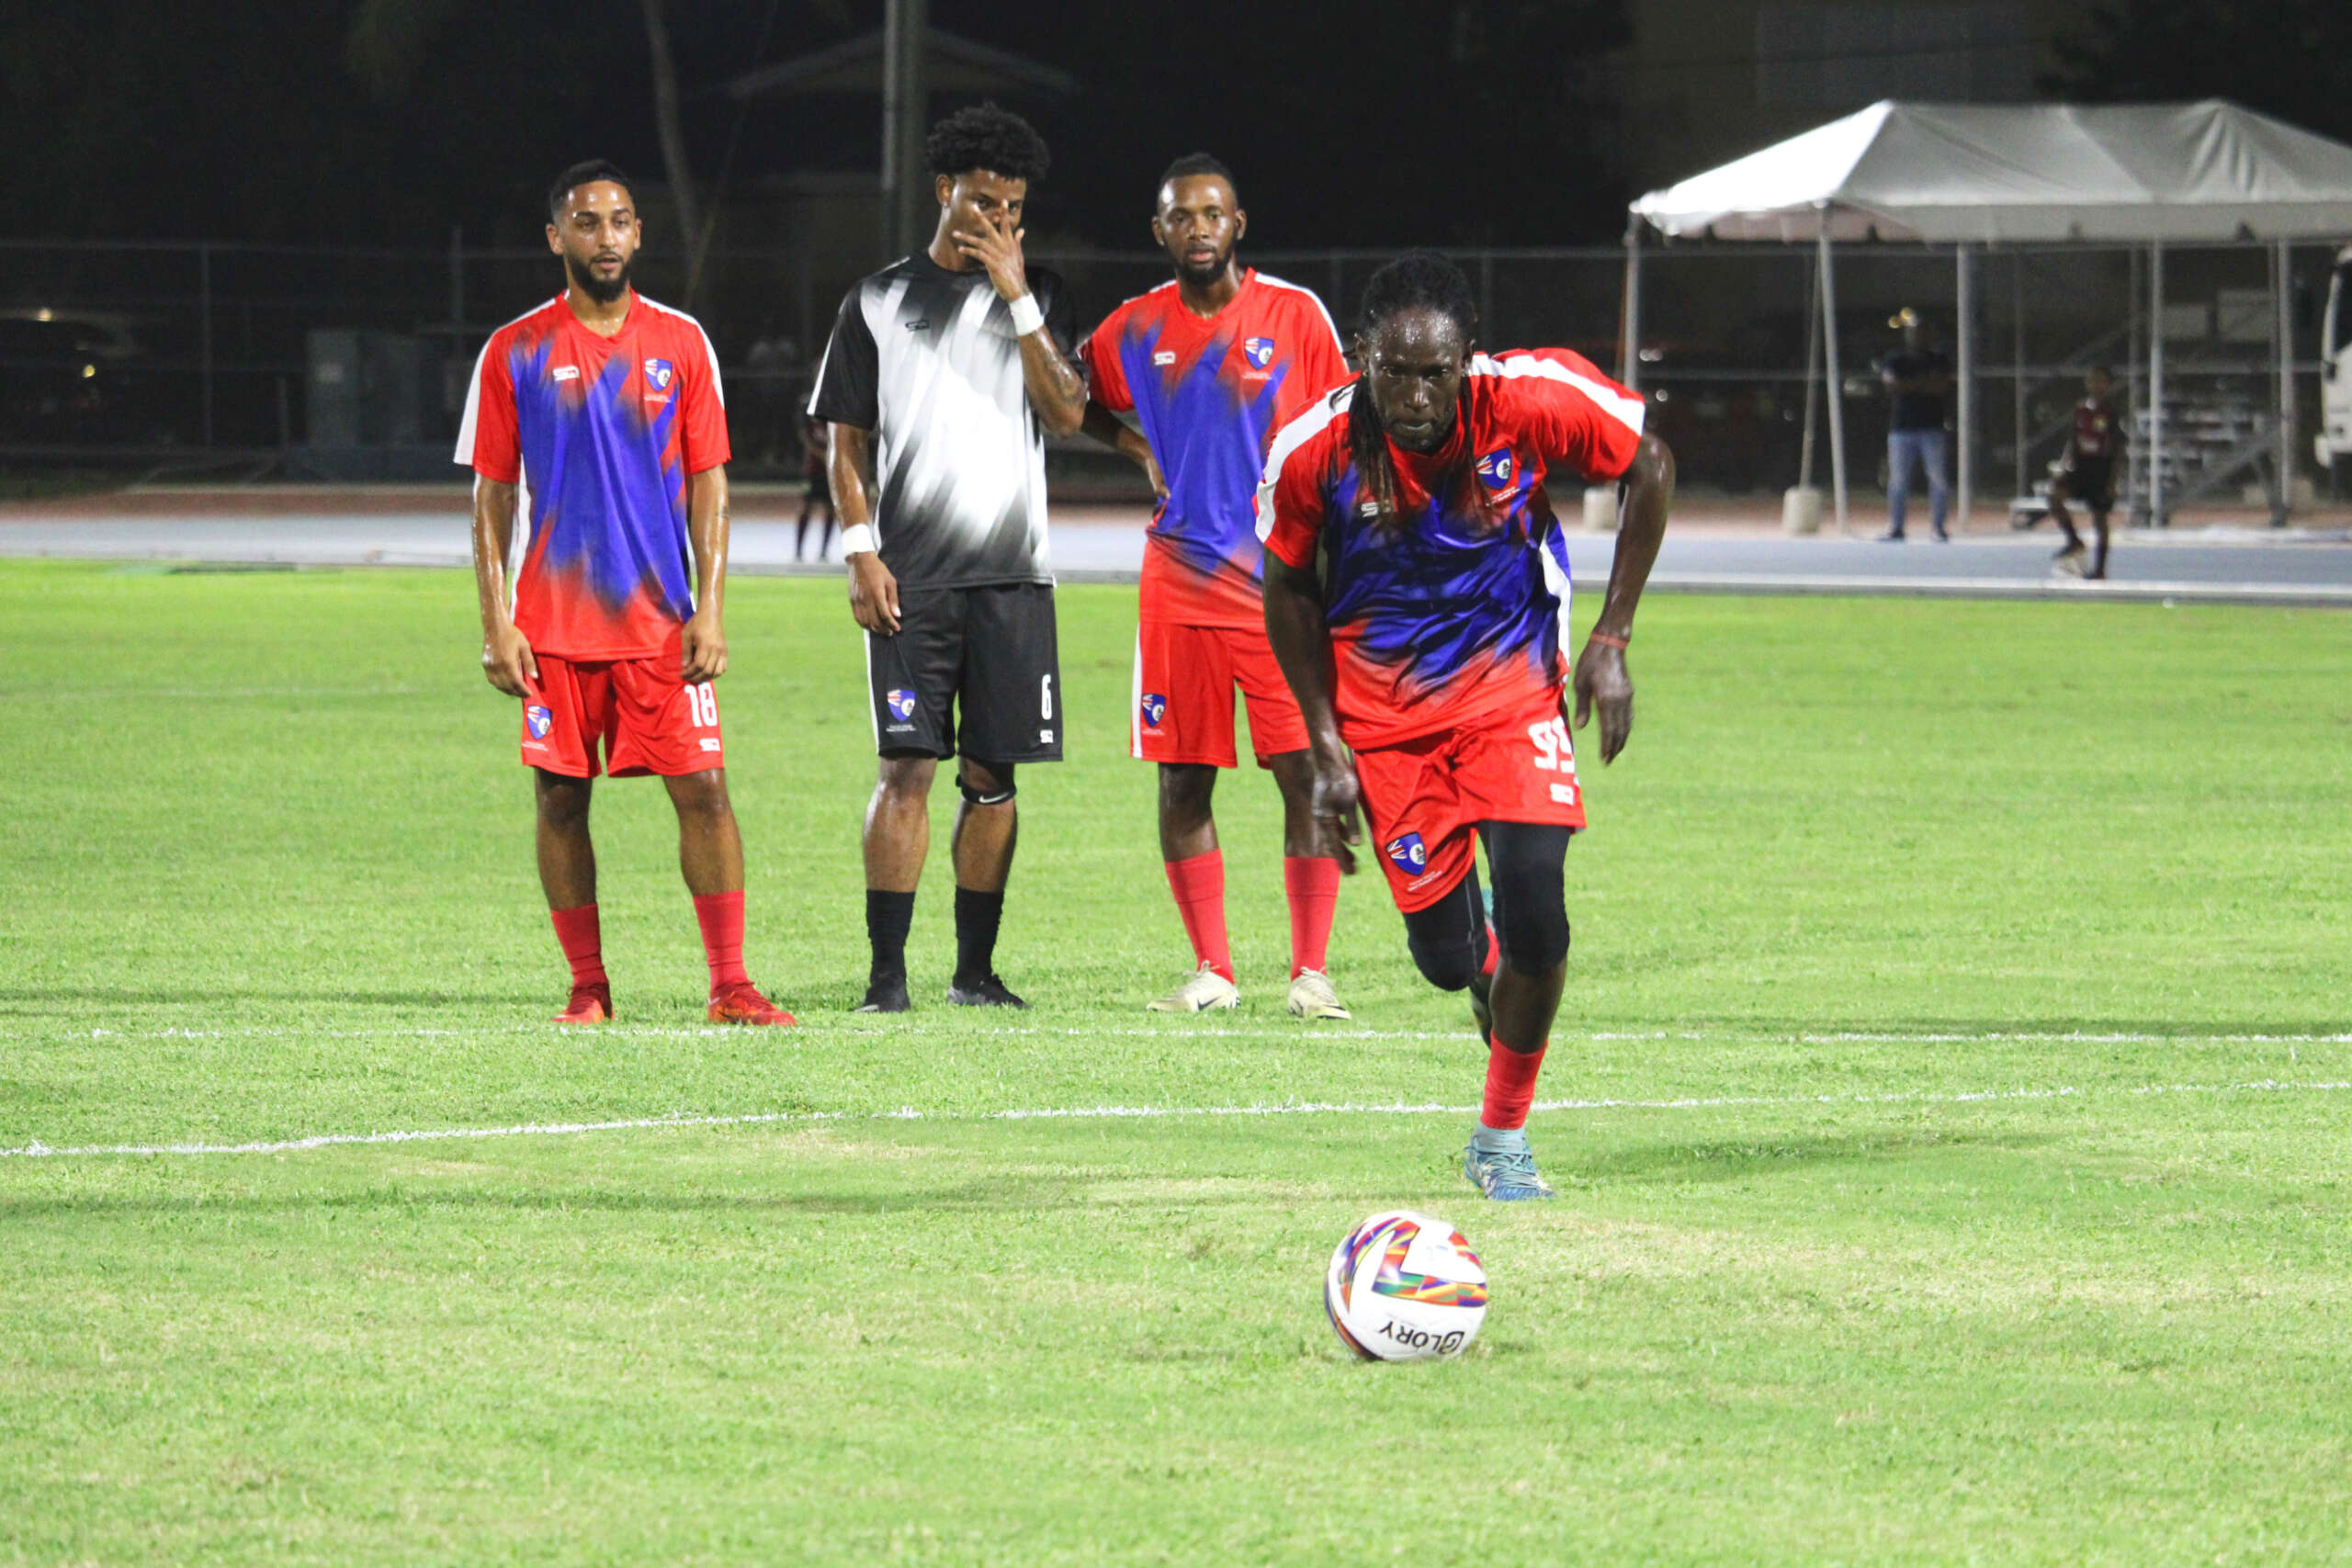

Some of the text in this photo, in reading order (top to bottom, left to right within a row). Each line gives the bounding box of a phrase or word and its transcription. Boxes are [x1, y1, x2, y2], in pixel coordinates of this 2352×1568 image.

[684, 682, 718, 728] 18
[1041, 673, 1052, 720] 6
[1378, 1321, 1465, 1355] GLORY
